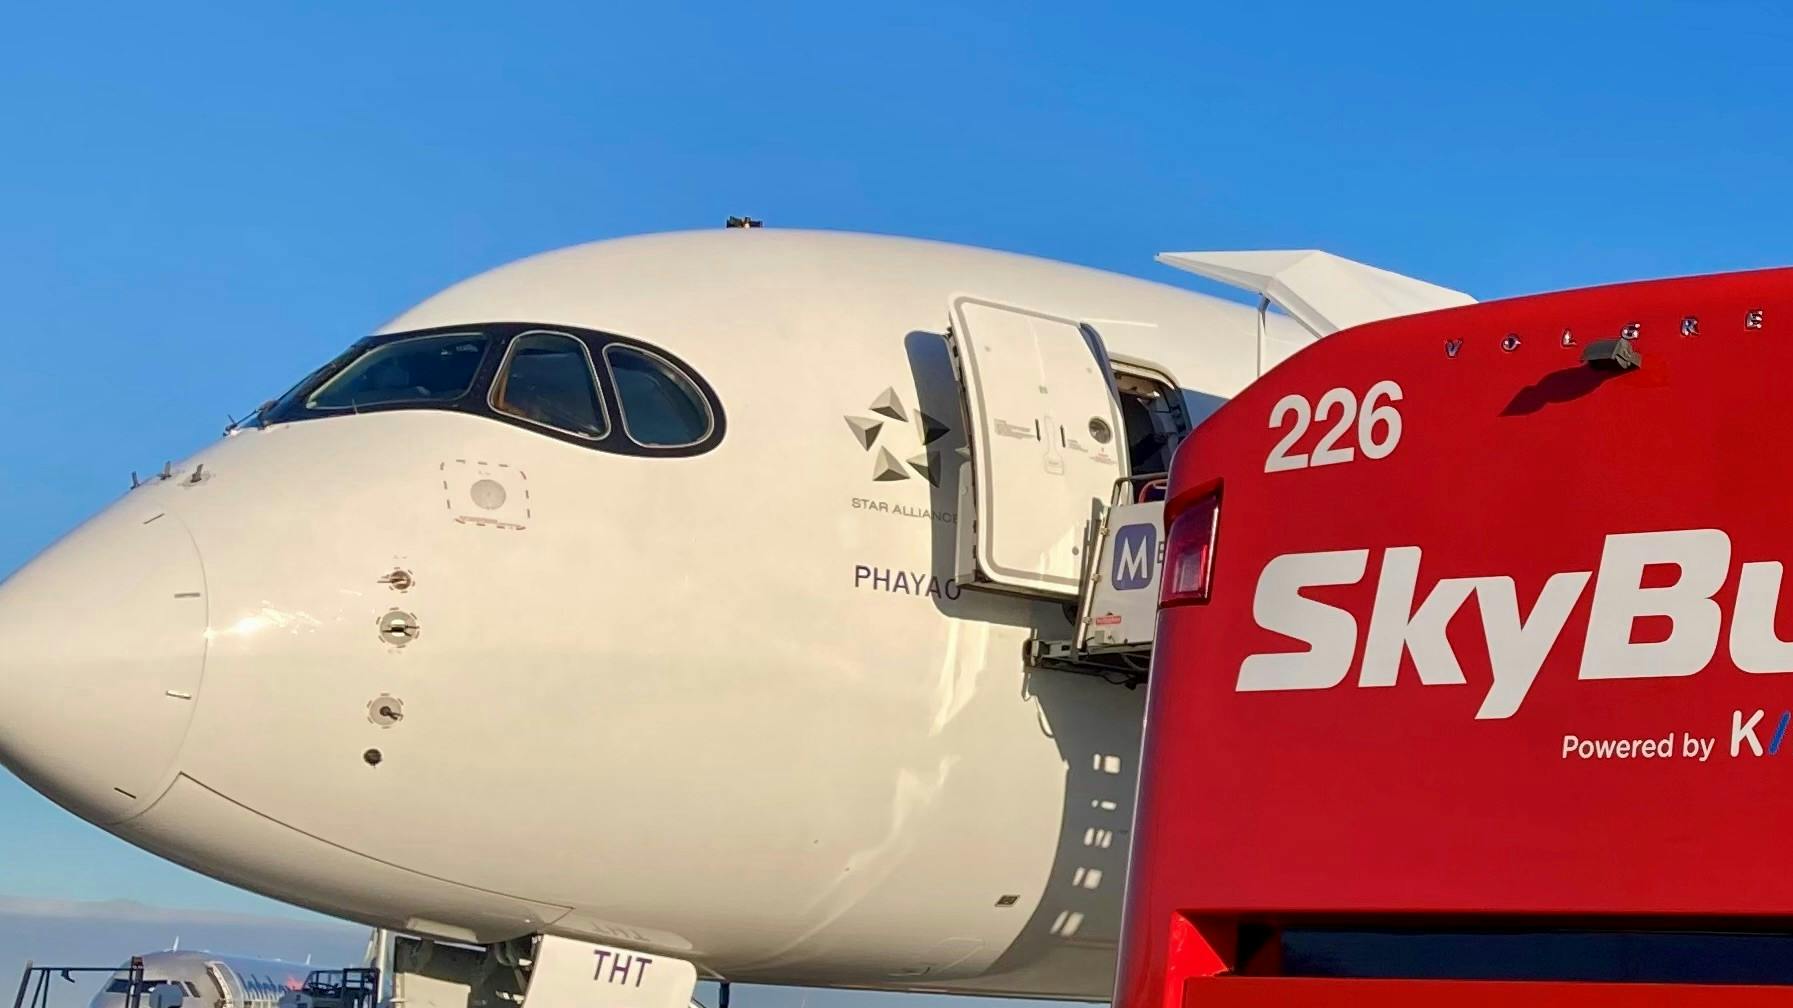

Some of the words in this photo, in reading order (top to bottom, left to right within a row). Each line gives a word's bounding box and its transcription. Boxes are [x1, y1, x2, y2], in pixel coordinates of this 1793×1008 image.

[1263, 379, 1403, 473] 226
[851, 497, 889, 513] STAR
[854, 564, 961, 601] PHAYAO
[1562, 731, 1674, 760] Powered
[1682, 732, 1716, 762] by
[593, 949, 653, 988] THT
